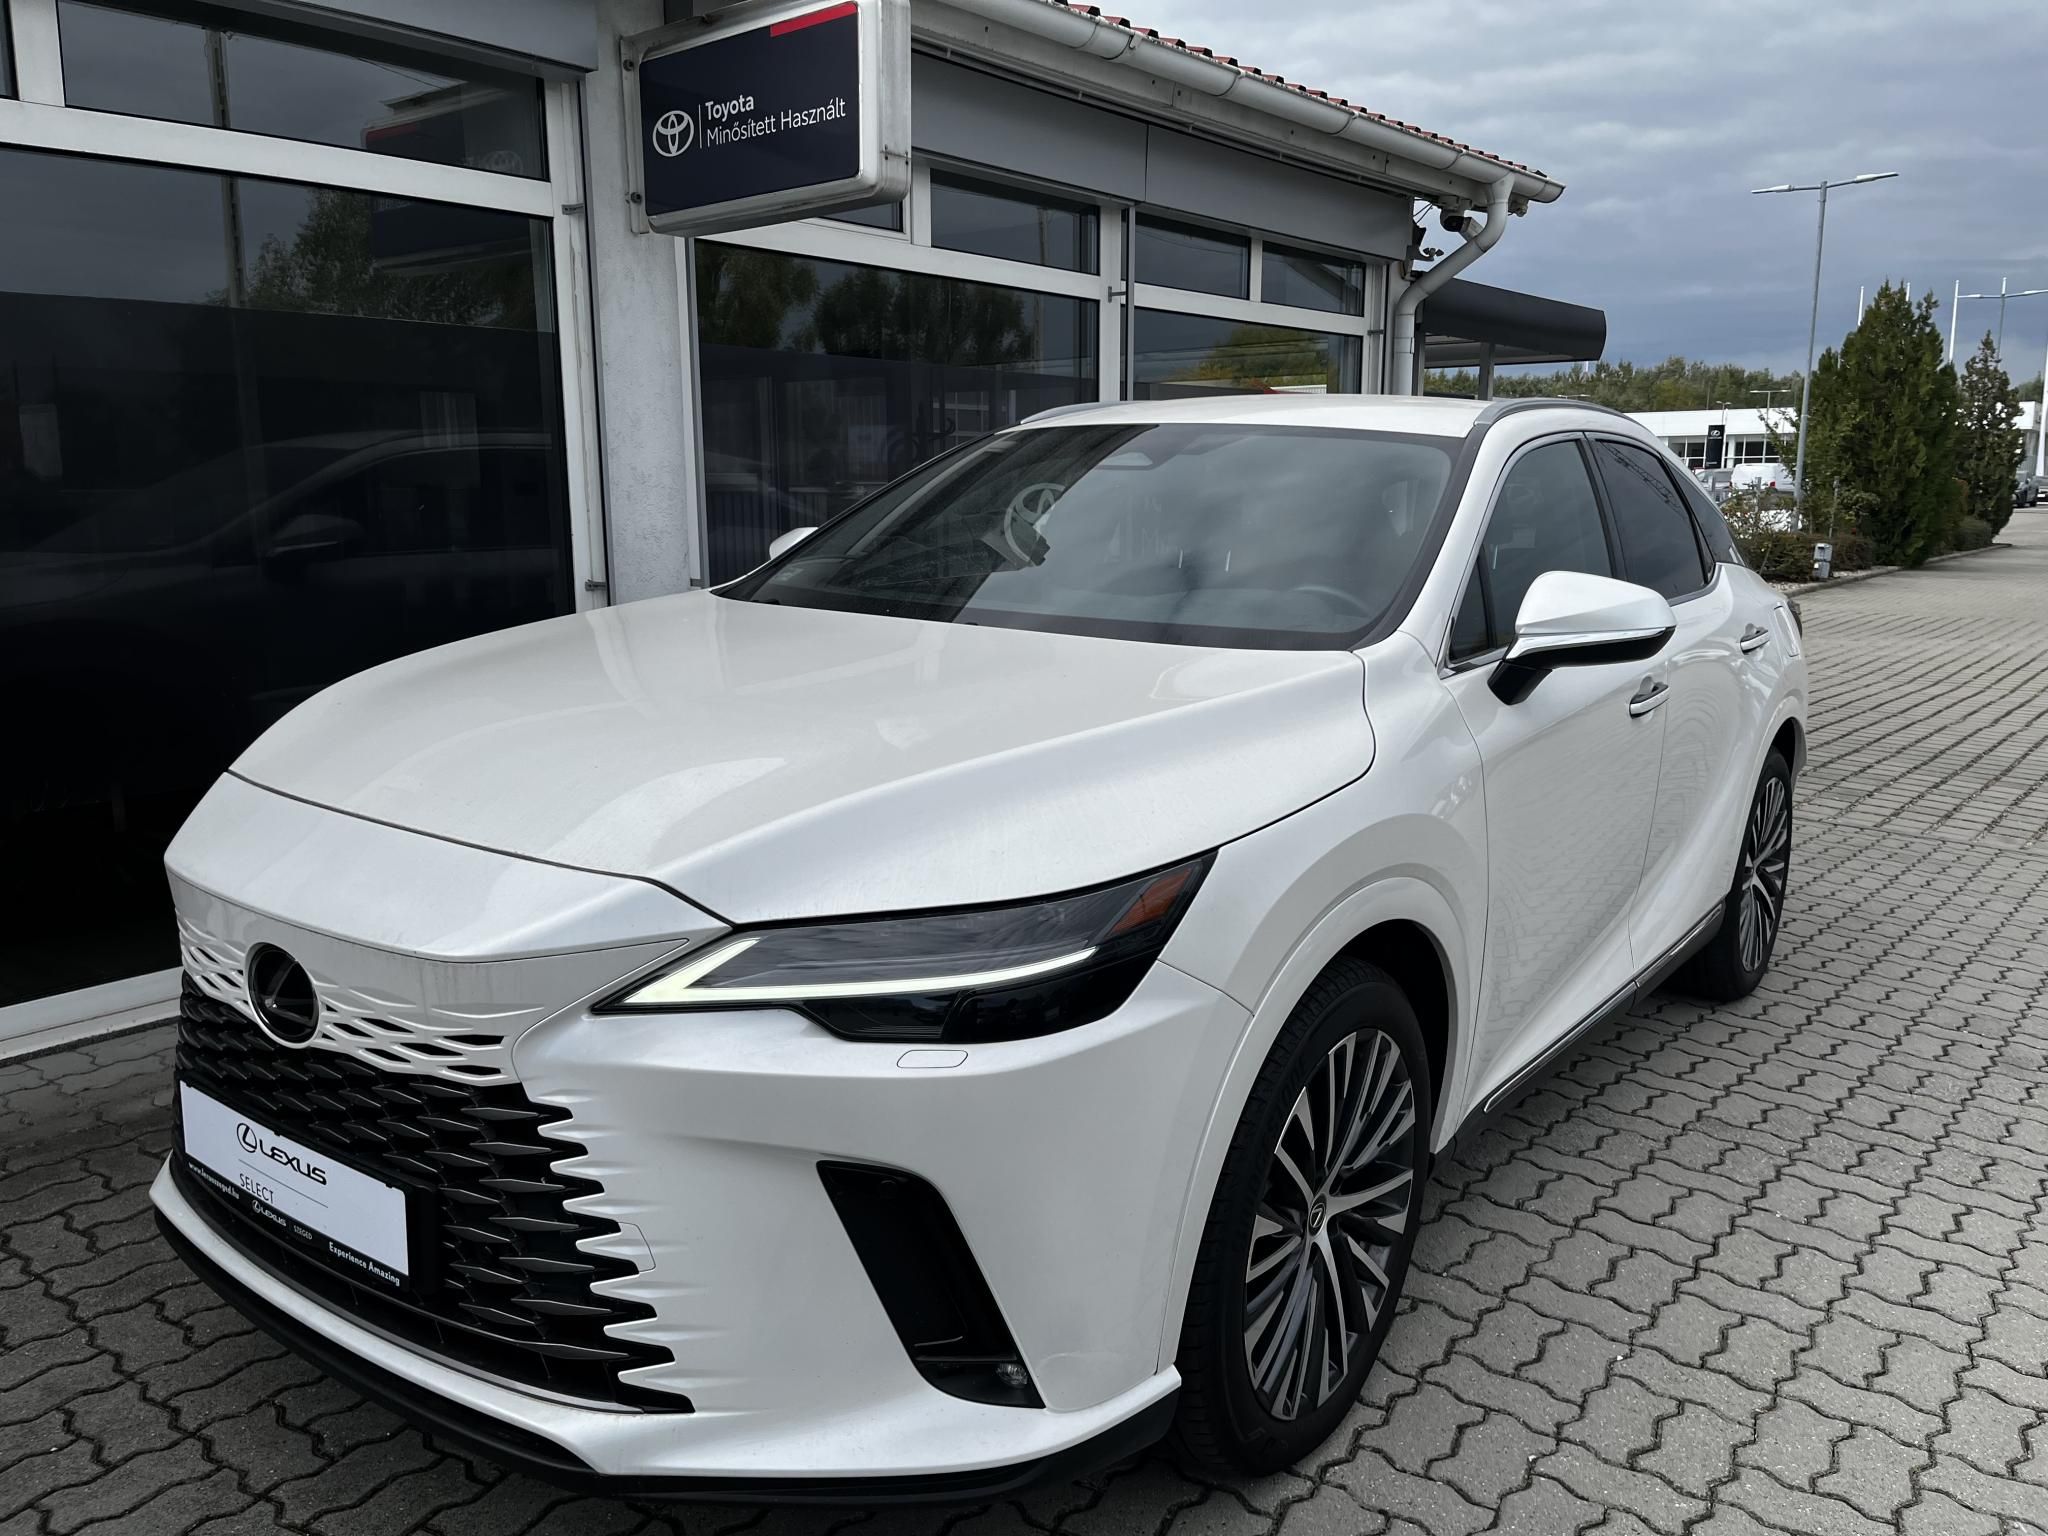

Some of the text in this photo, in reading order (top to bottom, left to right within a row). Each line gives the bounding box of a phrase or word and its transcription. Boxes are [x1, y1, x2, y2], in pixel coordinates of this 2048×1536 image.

[705, 95, 754, 121] Toyota
[707, 97, 846, 147] Minősített Használt
[259, 1139, 327, 1185] LEXUS
[240, 1173, 274, 1204] SELECT
[260, 1206, 287, 1226] LEXUS
[329, 1242, 400, 1286] Experience Amazing
